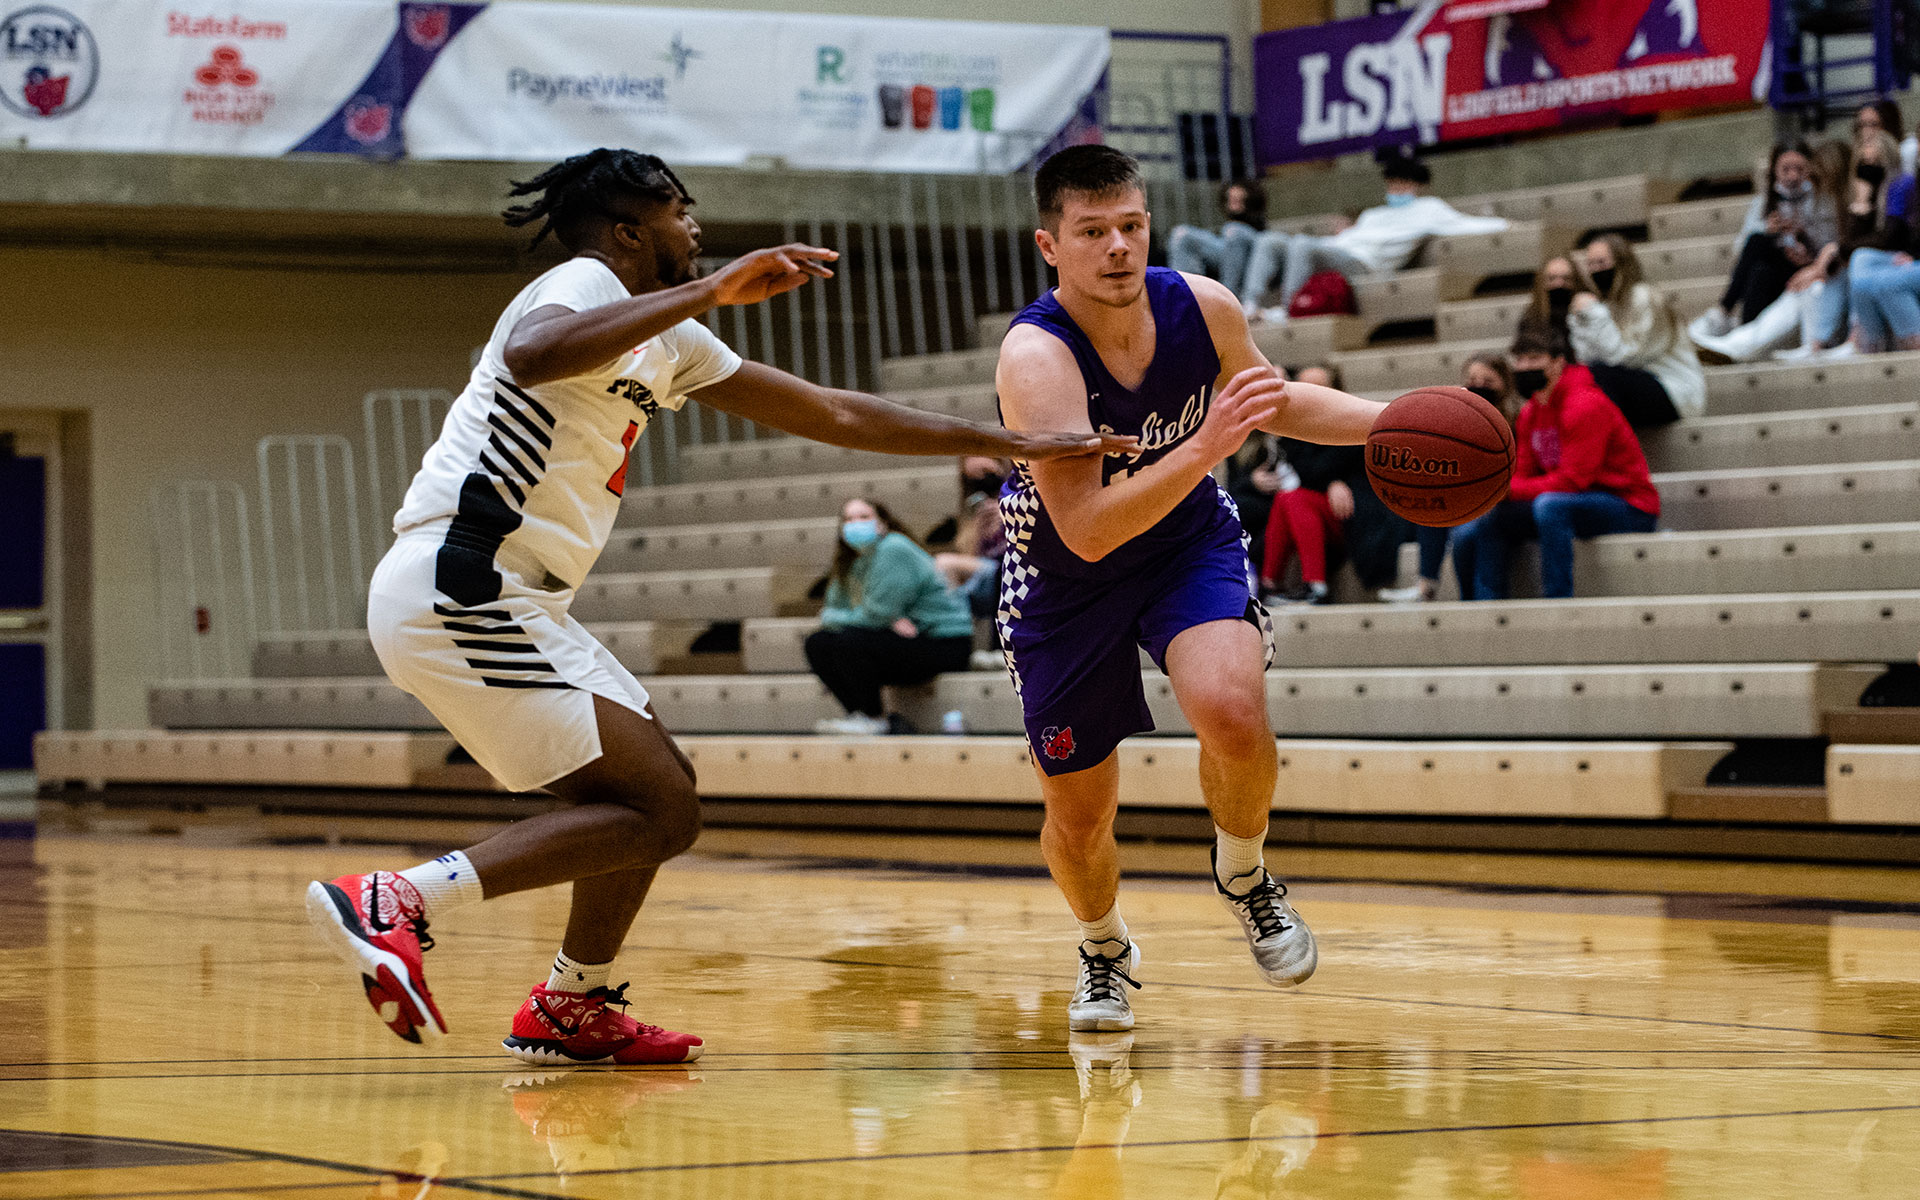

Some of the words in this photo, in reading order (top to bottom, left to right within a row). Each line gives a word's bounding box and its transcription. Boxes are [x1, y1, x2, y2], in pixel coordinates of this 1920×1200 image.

[7, 25, 81, 60] LSN
[507, 67, 666, 104] PayneWest
[1298, 33, 1452, 145] LSN
[1546, 70, 1625, 108] SPORTS
[1628, 53, 1737, 98] NETWORK
[1099, 384, 1206, 464] field
[1372, 443, 1460, 476] Wilson
[1381, 488, 1447, 510] NCAA
